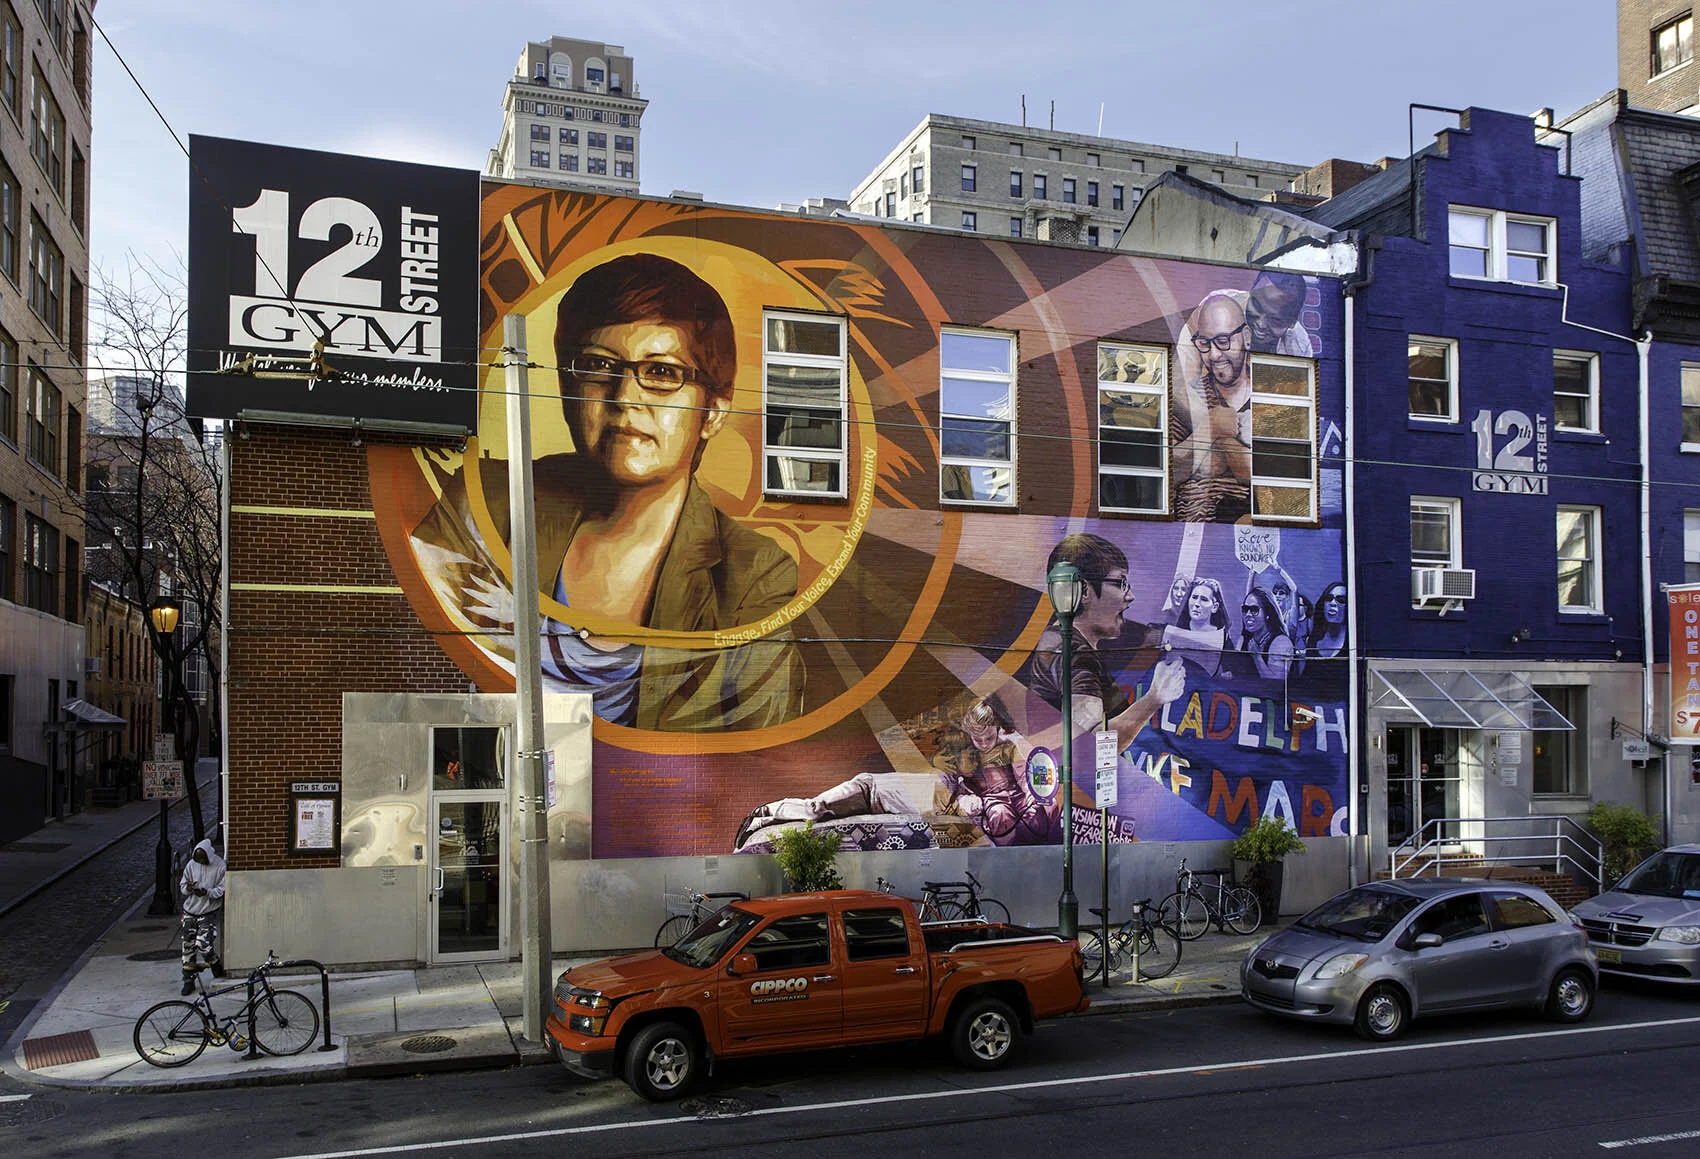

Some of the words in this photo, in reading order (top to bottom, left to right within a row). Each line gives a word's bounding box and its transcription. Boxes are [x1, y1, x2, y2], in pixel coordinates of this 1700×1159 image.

[400, 206, 439, 315] STREET
[241, 304, 432, 357] GYM
[1536, 413, 1548, 473] STREET
[1474, 473, 1544, 494] GYM
[760, 610, 785, 635] Find
[781, 600, 806, 620] Your
[802, 577, 833, 603] Voice,
[826, 540, 853, 578] Expand
[844, 517, 863, 542] Your
[855, 446, 877, 518] Community
[1238, 528, 1273, 544] Love
[1239, 544, 1263, 554] KNOWS
[1265, 544, 1276, 554] NO
[1684, 609, 1699, 655] ONE
[1686, 662, 1700, 707] TAN
[703, 990, 711, 999] 3
[750, 976, 808, 996] CIPPCO
